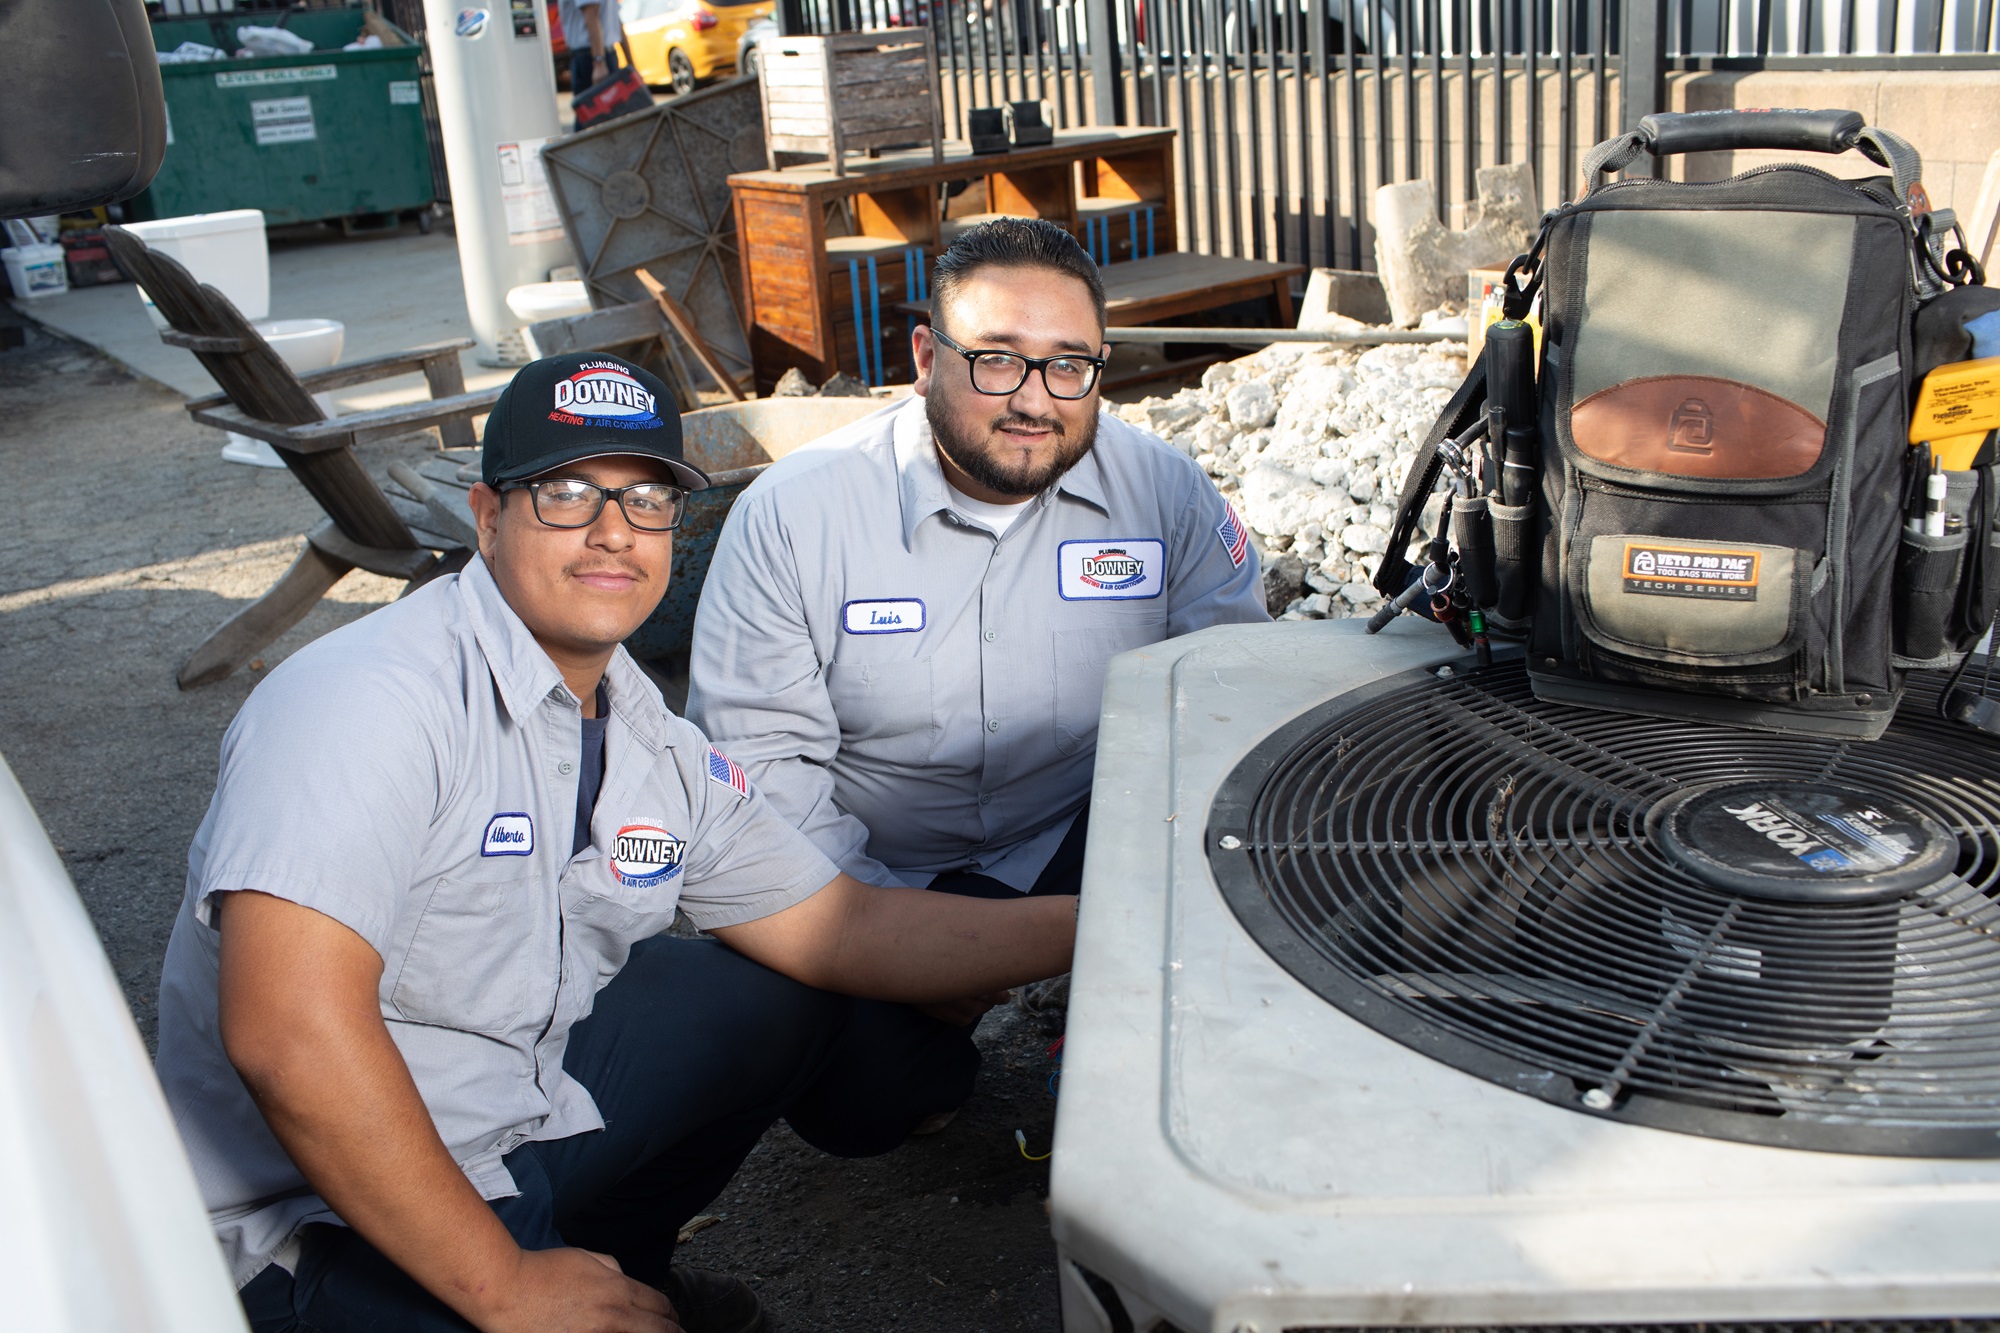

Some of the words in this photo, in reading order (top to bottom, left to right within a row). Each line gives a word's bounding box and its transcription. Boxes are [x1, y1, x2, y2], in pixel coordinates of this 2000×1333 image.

[218, 72, 259, 84] LEVEL
[264, 68, 297, 81] FULL
[300, 65, 333, 77] ONLY
[579, 360, 630, 375] PLUMBING
[555, 379, 656, 414] DOWNEY
[1934, 387, 1977, 397] Thermometer
[548, 411, 584, 426] HEATING
[585, 418, 592, 426] &
[595, 418, 612, 428] AIR
[613, 417, 664, 430] CONDITIONING
[1933, 408, 1973, 420] Fieldpiece
[1082, 557, 1144, 576] DOWNEY
[1657, 553, 1691, 566] VETO
[1693, 556, 1720, 569] PRO
[1657, 568, 1677, 577] TOOL
[1678, 570, 1700, 579] BAGS
[1701, 571, 1721, 579] THAT
[1721, 572, 1745, 580] WORK
[1080, 576, 1100, 588] HEATING
[1114, 575, 1146, 590] CONDITIONING
[1633, 580, 1676, 590] TECH
[1685, 585, 1748, 595] SERIES
[869, 610, 903, 625] Luis
[623, 816, 663, 828] PLUMBING
[489, 826, 525, 843] Alberto
[1722, 803, 1824, 857] YORK
[621, 875, 626, 885] &
[626, 878, 637, 888] AIR
[638, 864, 683, 889] CONDITIONING
